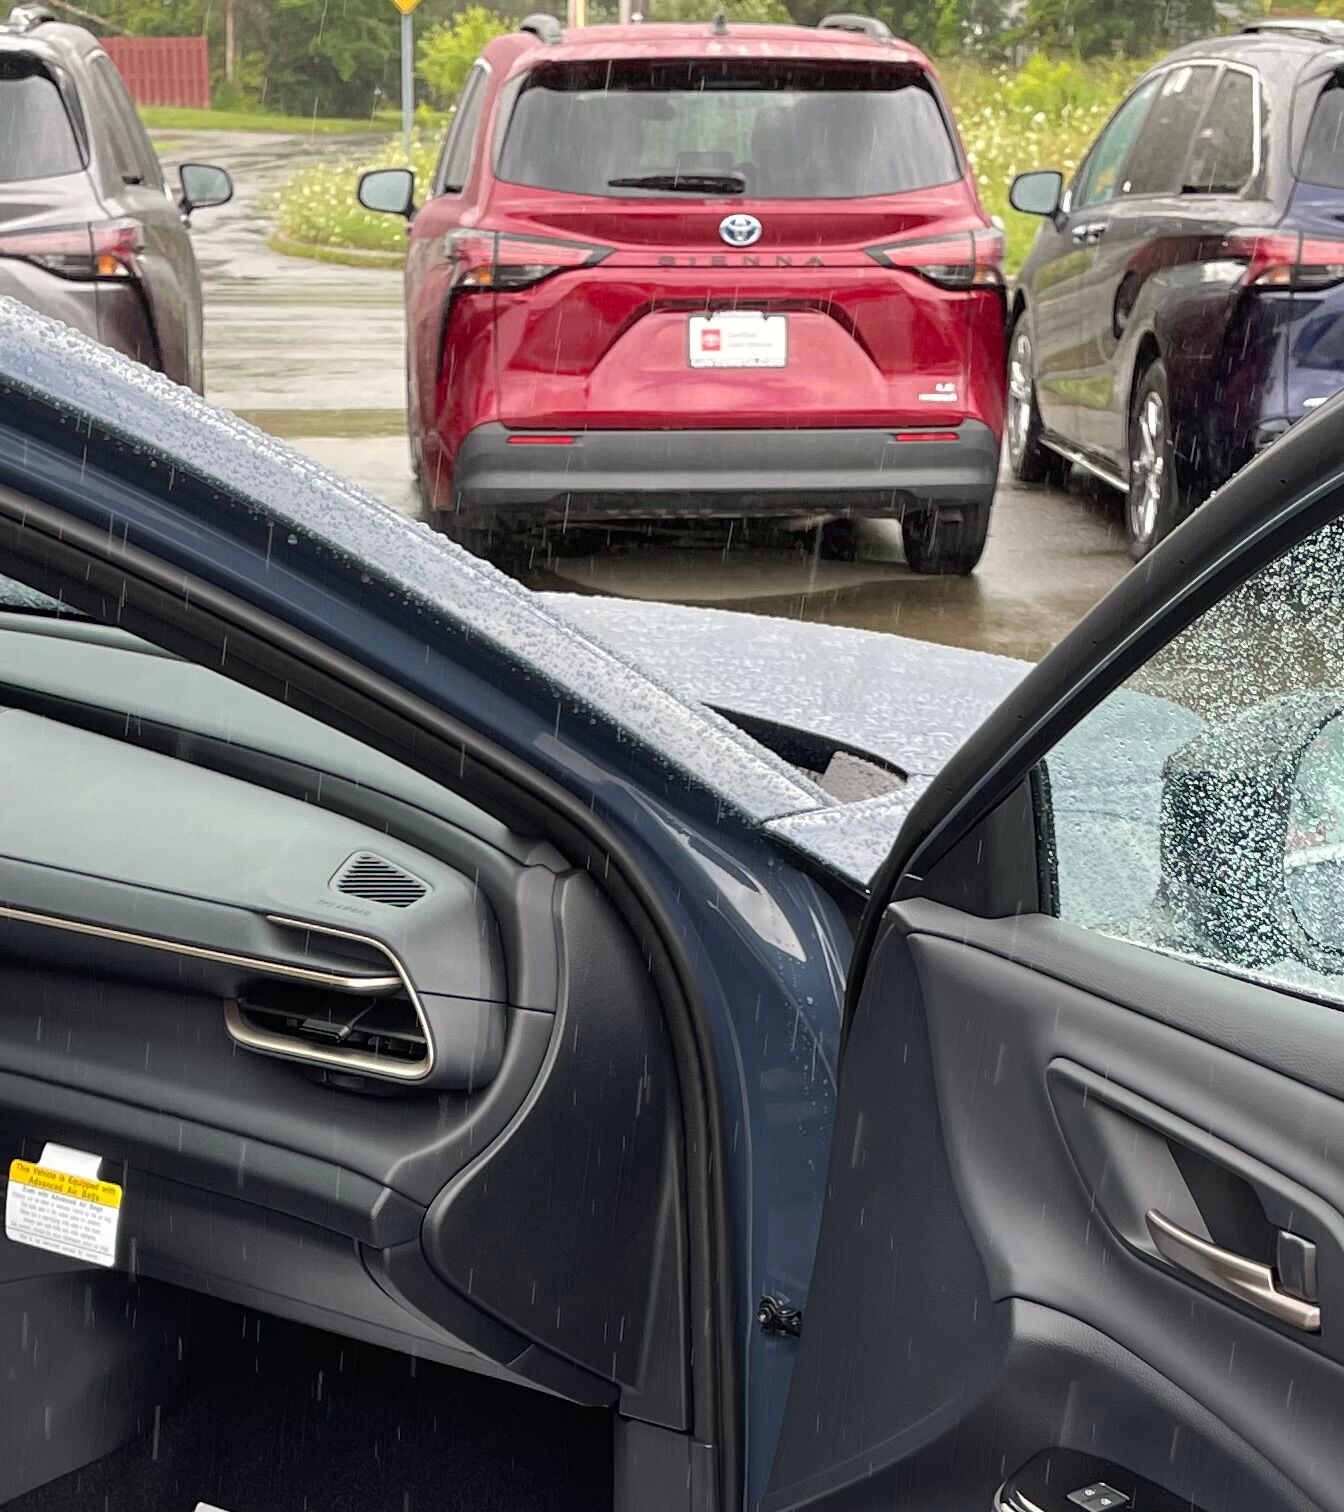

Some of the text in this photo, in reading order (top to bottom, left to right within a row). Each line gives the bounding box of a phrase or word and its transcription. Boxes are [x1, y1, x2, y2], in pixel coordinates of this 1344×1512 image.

[657, 255, 826, 267] SIENNA
[16, 1163, 30, 1174] This
[33, 1166, 56, 1180] Vehicle
[68, 1174, 99, 1190] Equipped
[28, 1176, 100, 1202] Advanced Air Bags
